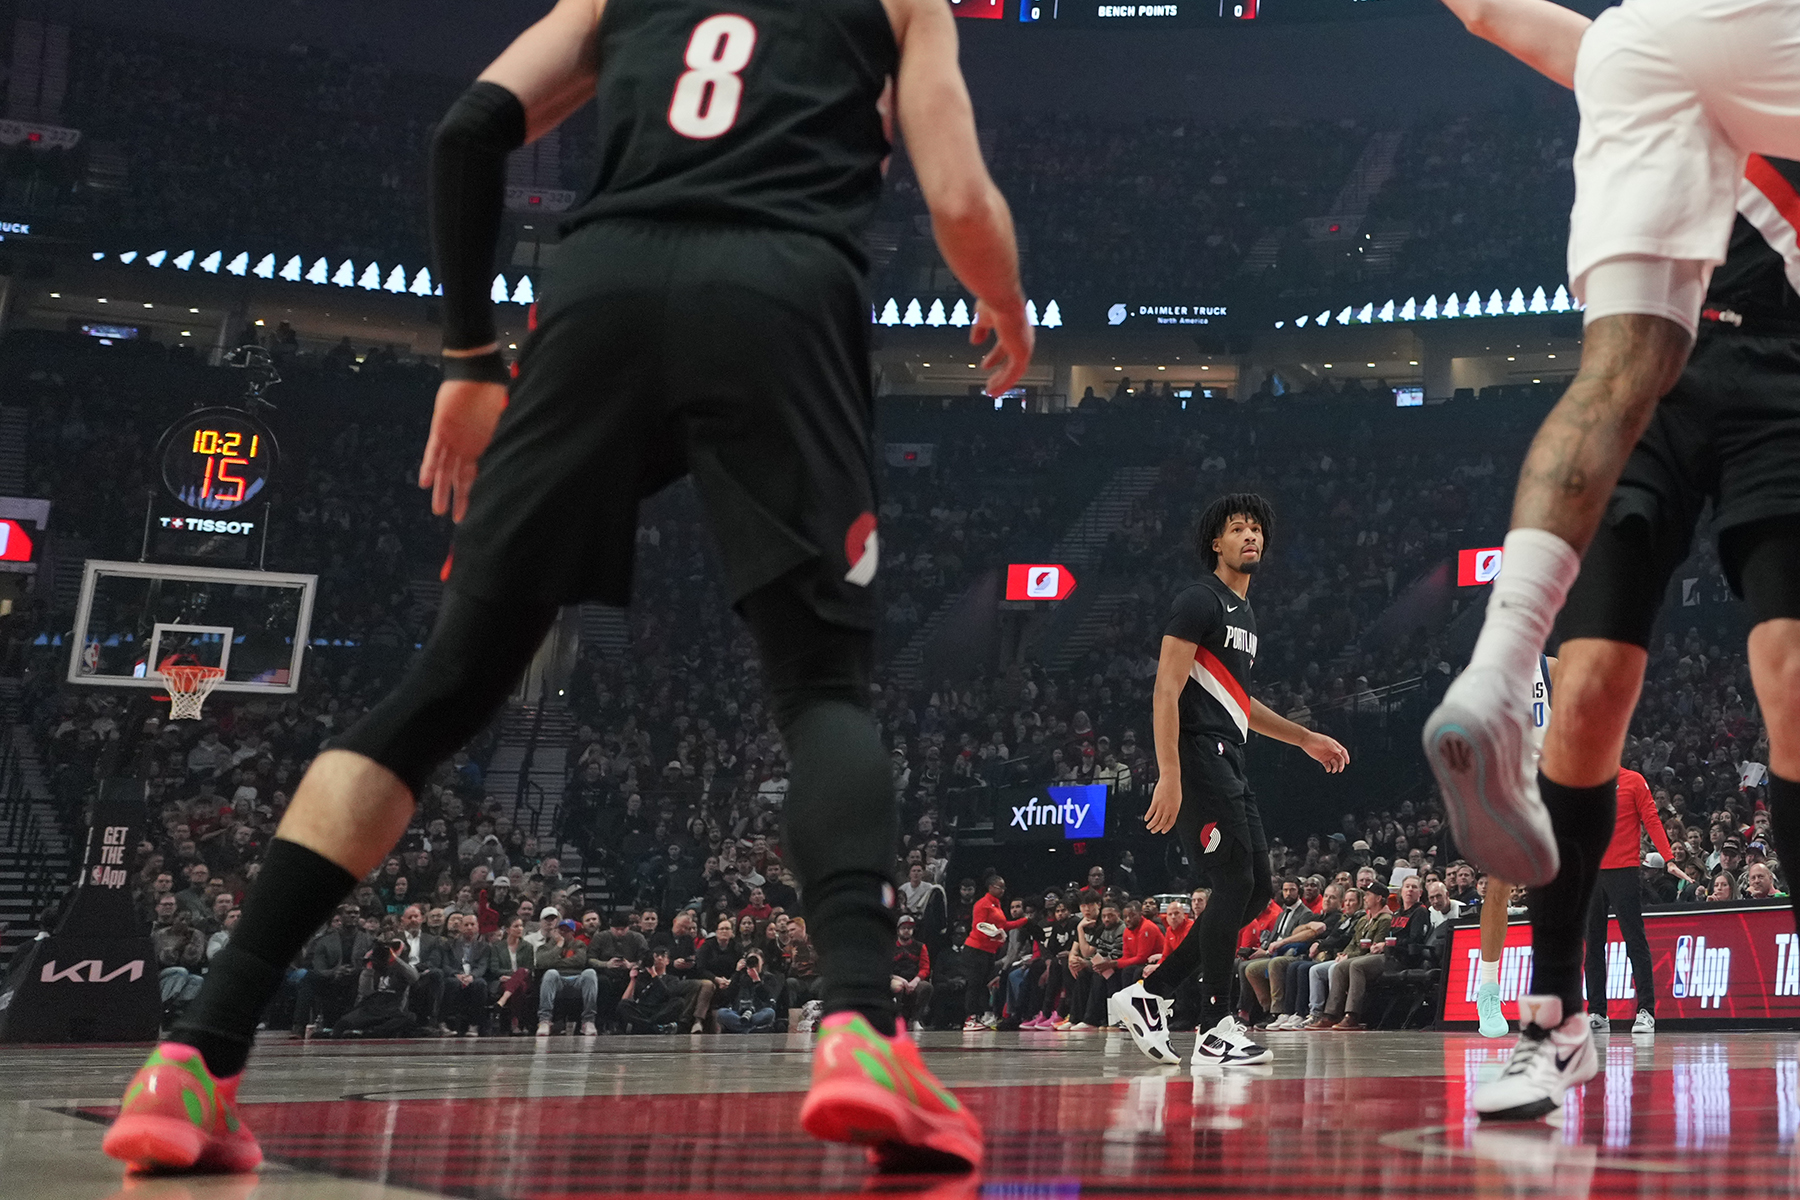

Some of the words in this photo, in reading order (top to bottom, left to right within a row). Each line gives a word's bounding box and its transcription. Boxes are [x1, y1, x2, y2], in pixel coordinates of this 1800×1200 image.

[1098, 6, 1136, 17] BENCH
[1138, 5, 1178, 16] POINTS
[667, 12, 758, 140] 8
[1139, 305, 1188, 316] DAIMLER
[1193, 306, 1227, 316] TRUCK
[193, 429, 259, 458] 10:21
[202, 456, 249, 501] 15
[186, 518, 254, 534] TISSOT
[1010, 797, 1090, 831] xfinity
[103, 827, 129, 845] GET
[101, 846, 126, 865] THE
[101, 866, 127, 889] App
[40, 960, 145, 982] KIA
[1689, 936, 1731, 1009] App
